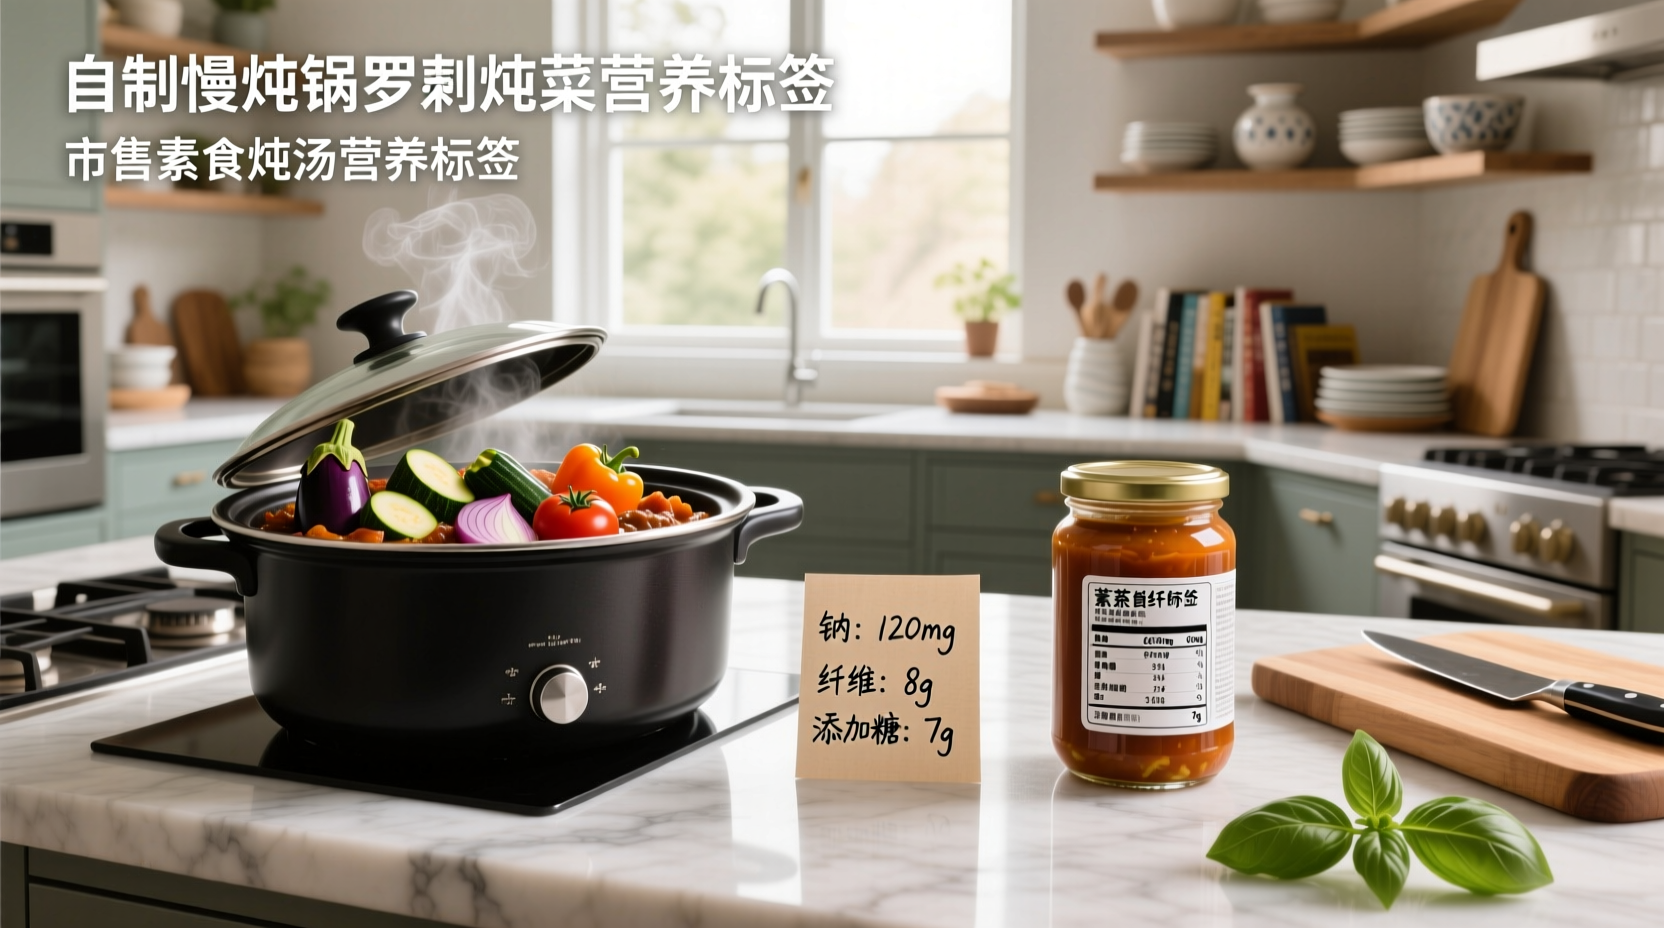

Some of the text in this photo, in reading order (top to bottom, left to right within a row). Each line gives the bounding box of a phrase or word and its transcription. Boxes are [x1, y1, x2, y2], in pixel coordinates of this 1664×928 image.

[878, 614, 956, 656] 120mg
[904, 666, 933, 709] 8g
[924, 716, 954, 758] 7g
[1192, 711, 1201, 723] 7g
